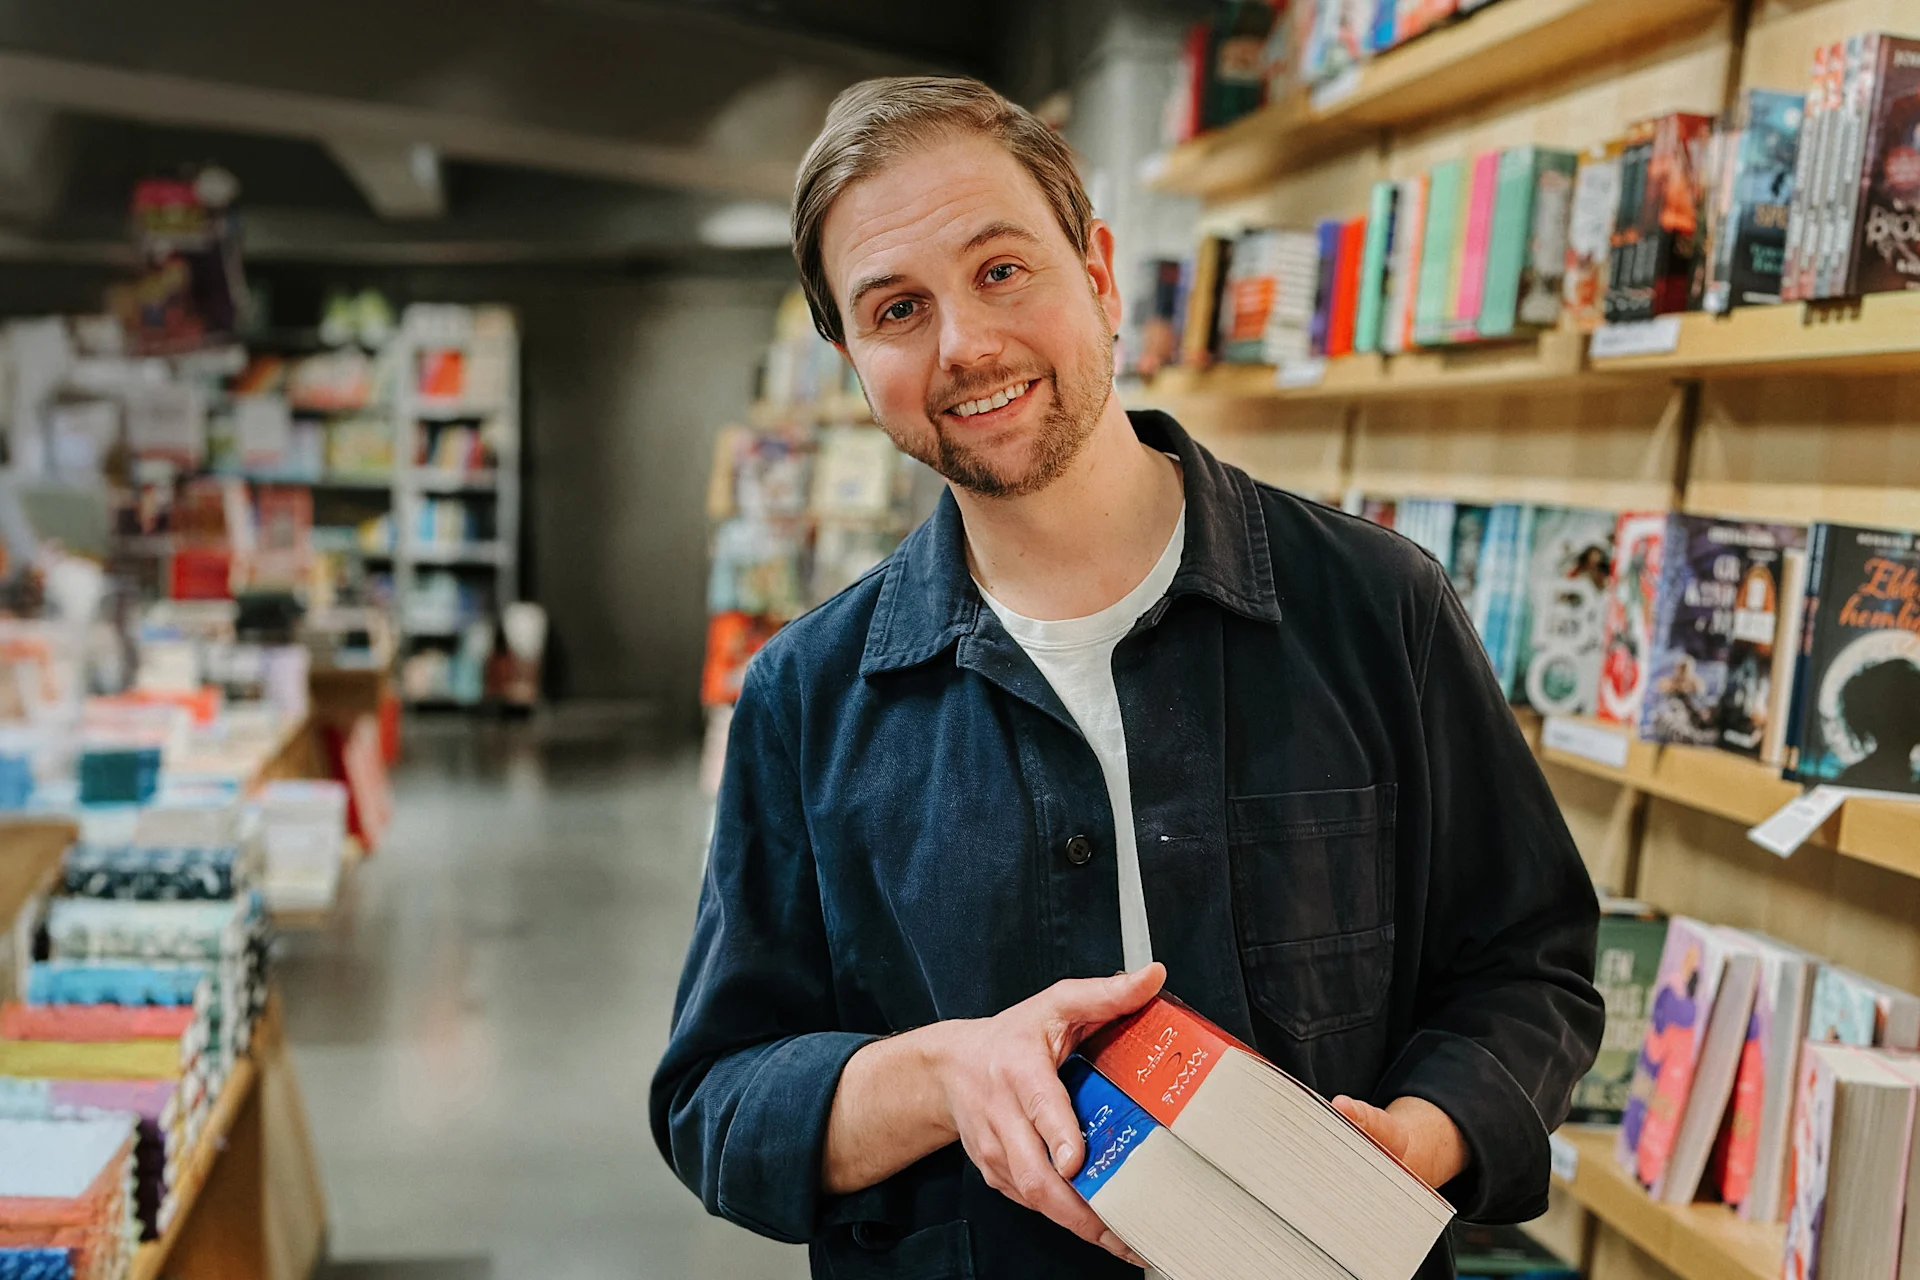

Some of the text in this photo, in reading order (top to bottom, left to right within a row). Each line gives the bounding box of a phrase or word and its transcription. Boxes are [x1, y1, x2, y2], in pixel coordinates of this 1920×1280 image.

[1136, 1027, 1173, 1081] CITY
[1141, 1031, 1178, 1083] CRESCENT
[1161, 1047, 1203, 1102] MAAS
[1176, 1052, 1208, 1095] SARAH
[1087, 1125, 1132, 1176] MAAS
[1101, 1130, 1137, 1170] SARAH
